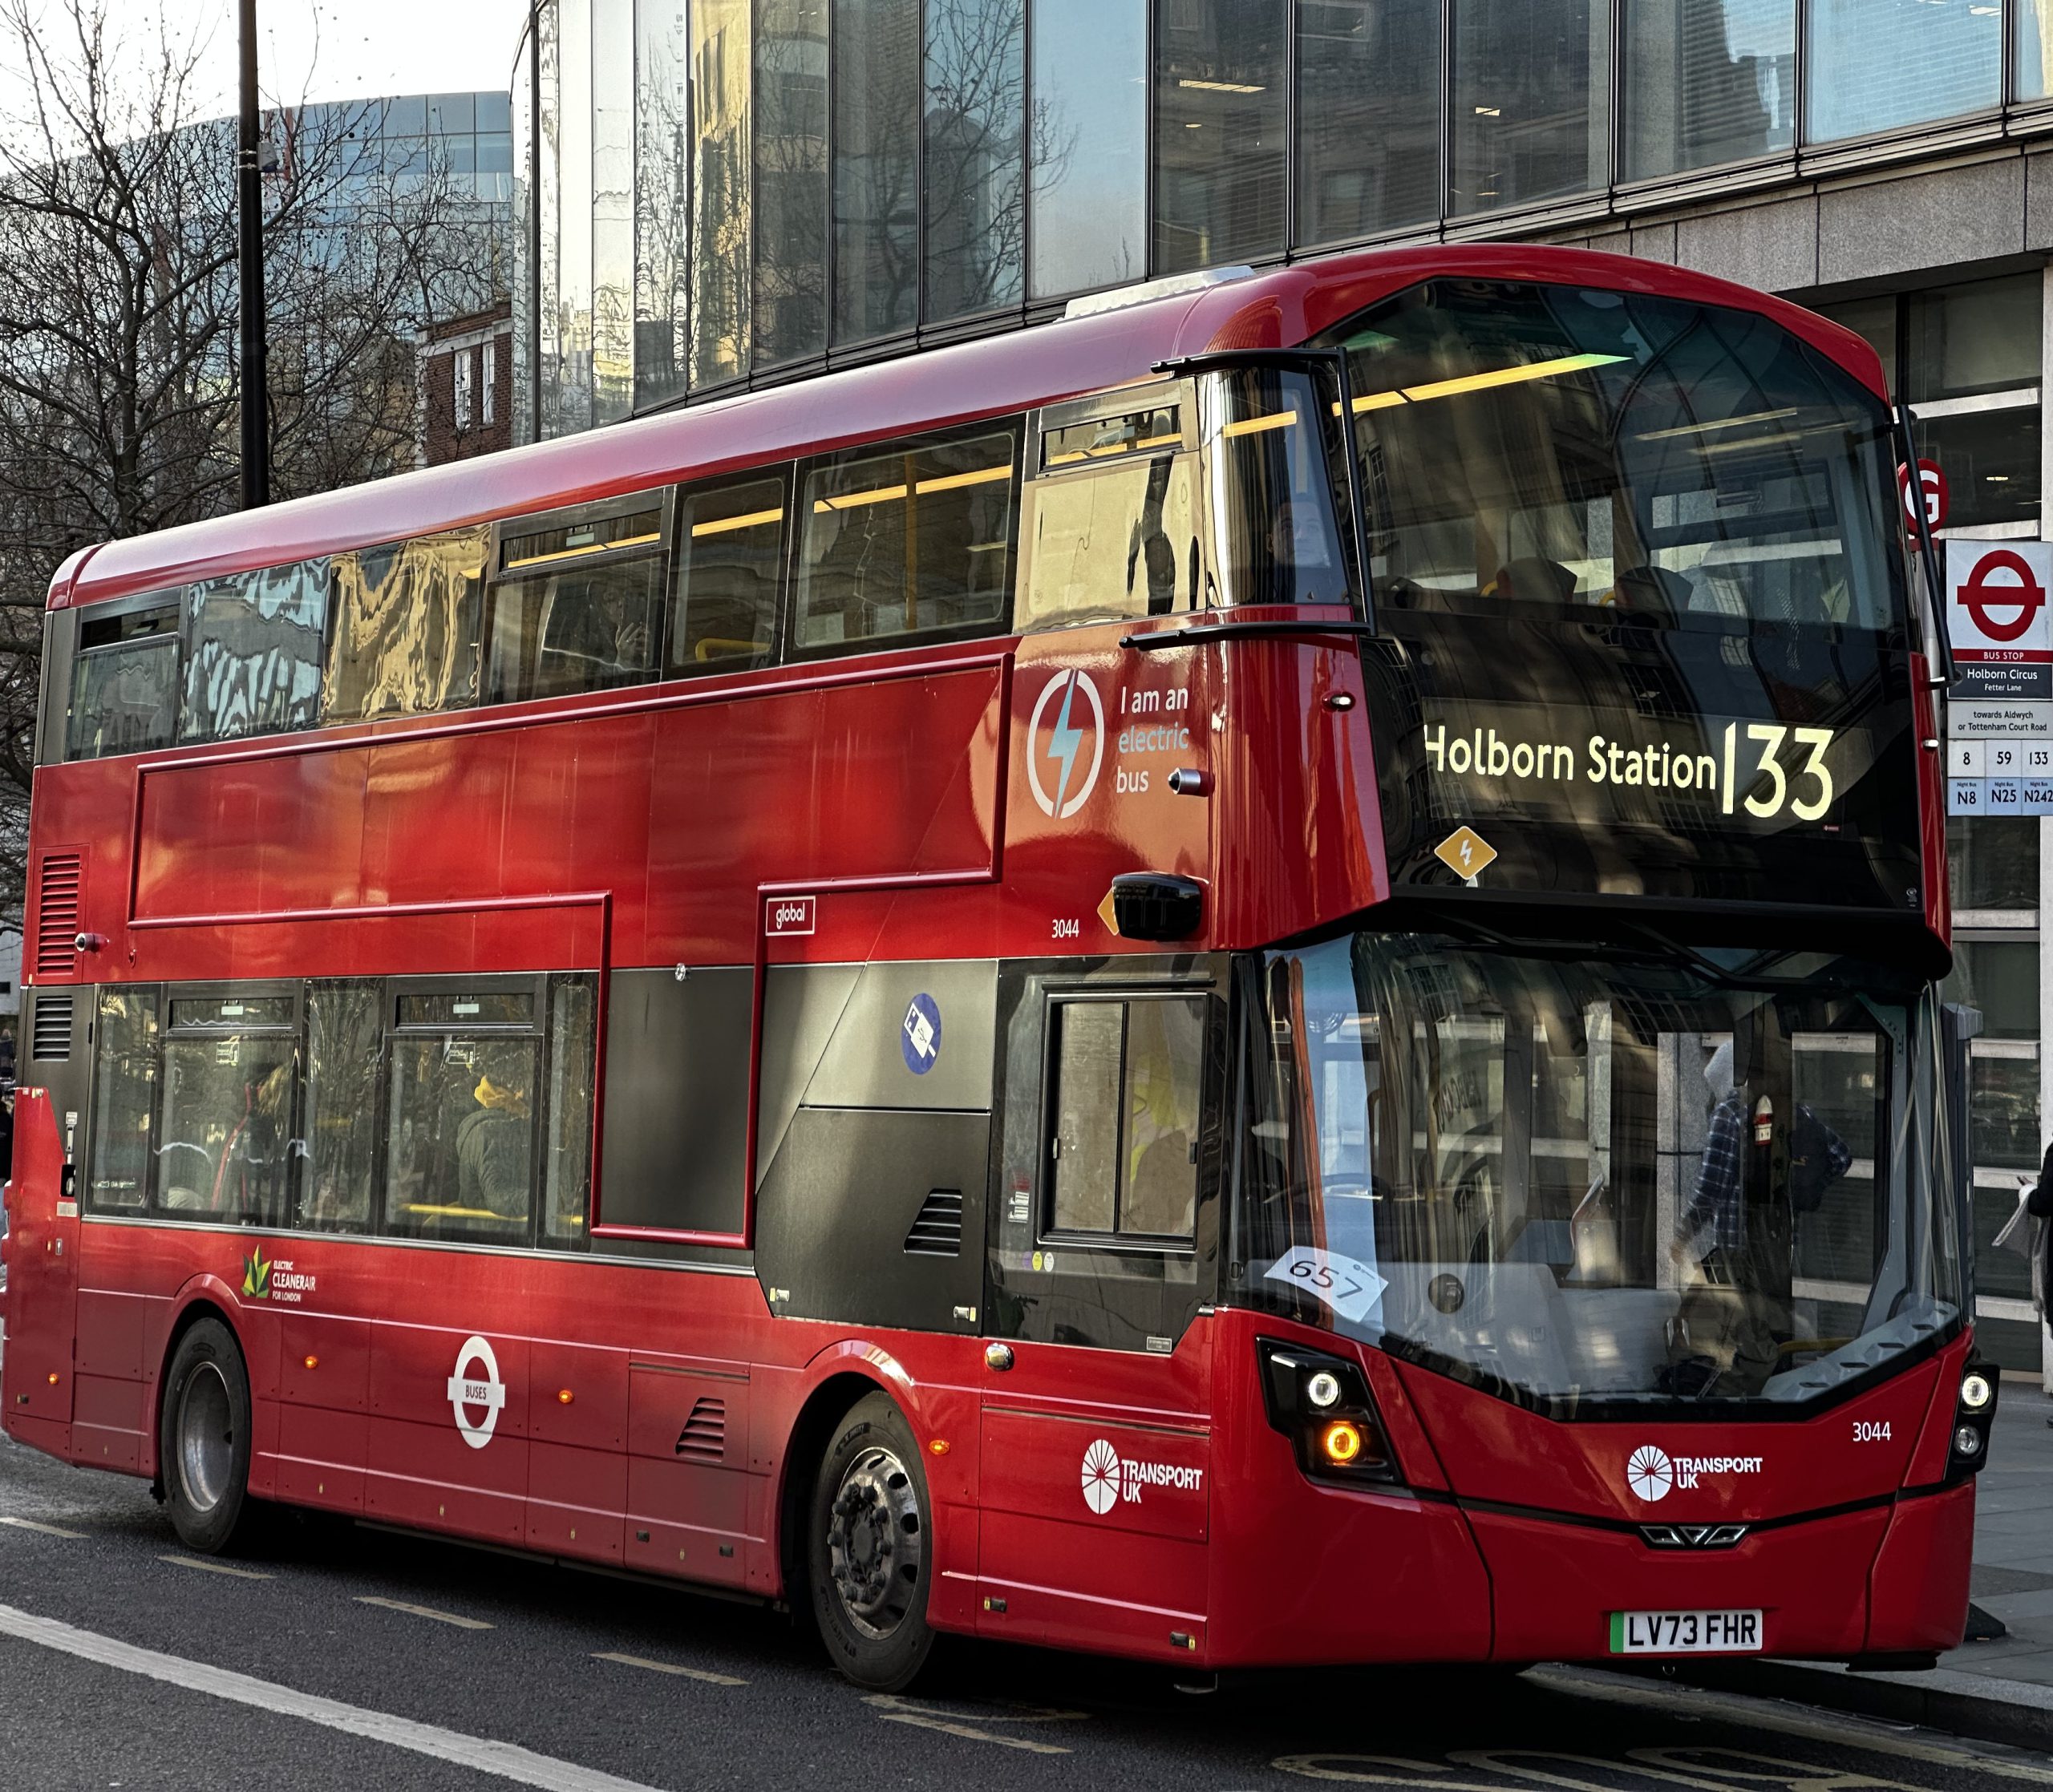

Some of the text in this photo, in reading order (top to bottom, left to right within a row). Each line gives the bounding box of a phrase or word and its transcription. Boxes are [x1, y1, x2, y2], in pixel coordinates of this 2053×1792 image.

[1983, 651, 2024, 661] BUS STOP
[1966, 668, 2039, 681] Holborn Circus
[1984, 682, 2022, 692] Fetter Lane
[1120, 686, 1188, 714] I am an
[1973, 710, 2034, 721] towards Aldwych
[1967, 722, 2007, 731] Tottenham
[2008, 722, 2029, 731] Court
[2031, 722, 2047, 731] Road
[1118, 721, 1189, 754] electric
[1962, 751, 1971, 766] 8
[1996, 750, 2012, 765] 59
[2029, 751, 2048, 766] 133
[1423, 721, 1834, 821] Holborn Station 133
[1116, 765, 1149, 794] bus
[1957, 791, 1977, 805] N8
[1991, 789, 2017, 803] N25
[2024, 790, 2053, 803] N242
[775, 901, 805, 930] global
[1051, 918, 1079, 939] 3044
[273, 1260, 294, 1272] ELECTRIC
[1289, 1260, 1363, 1300] 657
[272, 1290, 302, 1303] FOR LONDON
[465, 1384, 487, 1401] BUSES
[1852, 1422, 1892, 1442] 3044
[1672, 1457, 1763, 1474] TRANSPORT
[1121, 1458, 1203, 1491] TRANSPORT
[1677, 1473, 1699, 1489] UK
[1123, 1481, 1142, 1504] UK
[1628, 1613, 1757, 1646] LV73 FHR
